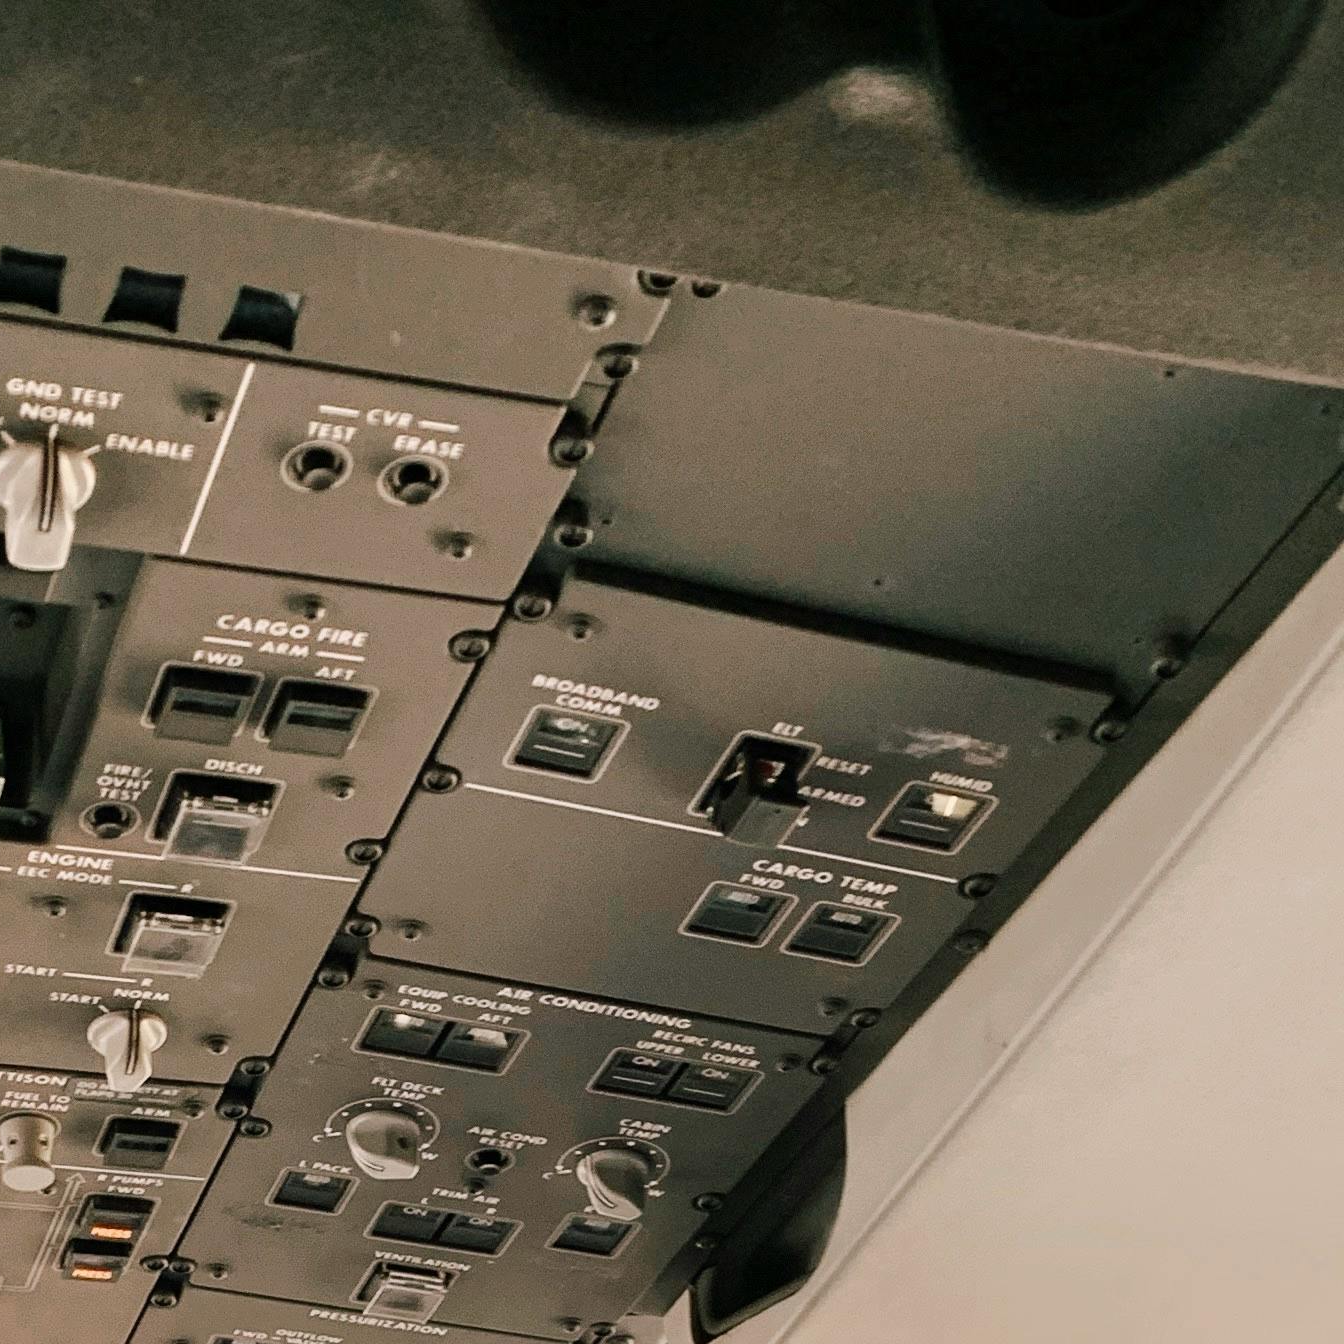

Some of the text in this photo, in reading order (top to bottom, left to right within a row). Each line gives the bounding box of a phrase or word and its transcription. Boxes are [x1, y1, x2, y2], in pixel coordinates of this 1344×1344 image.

[6, 378, 123, 409] GND TEST
[20, 402, 95, 429] NORM
[365, 408, 414, 430] CVR
[307, 422, 357, 443] TEST
[105, 434, 195, 461] ENABLE
[394, 435, 464, 460] ERASE
[216, 613, 368, 648] CARGO FIRE
[192, 650, 245, 668] FWD
[315, 664, 357, 682] AFT
[531, 674, 660, 711] BROADBAND
[204, 758, 265, 777] DISCH
[99, 789, 142, 804] TEST
[27, 850, 114, 873] ENGINE
[60, 869, 112, 888] MODE
[752, 859, 898, 897] CARGO TEMP
[399, 999, 442, 1014] FWD
[452, 993, 531, 1016] COOLING
[496, 986, 692, 1029] AIR CONDITIONING
[479, 1012, 515, 1025] AFT
[374, 1250, 471, 1272] VENTILATION
[310, 1309, 449, 1337] PRESSURIZATION
